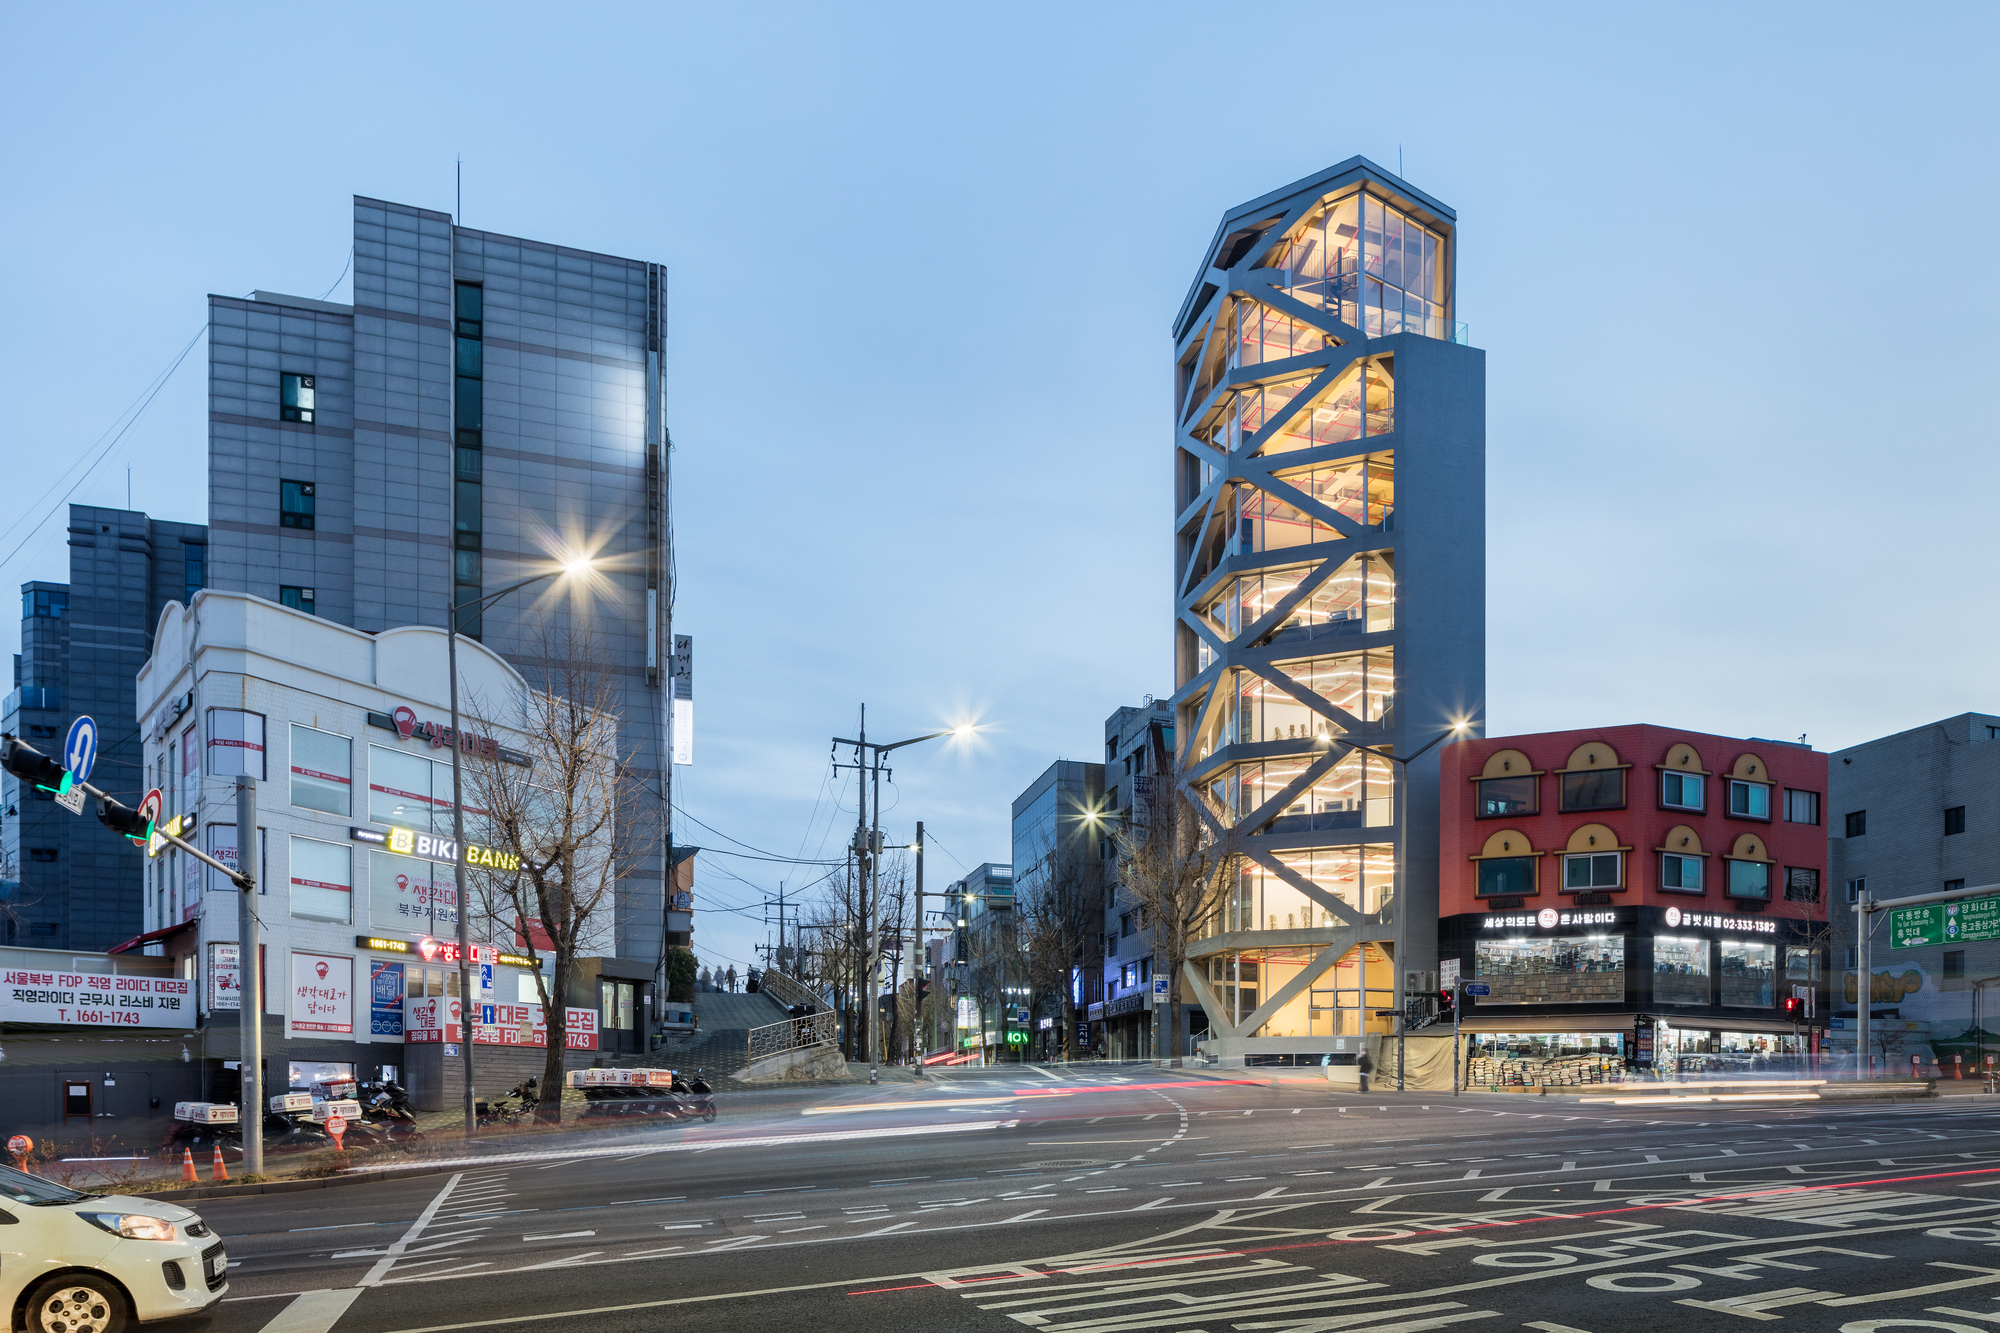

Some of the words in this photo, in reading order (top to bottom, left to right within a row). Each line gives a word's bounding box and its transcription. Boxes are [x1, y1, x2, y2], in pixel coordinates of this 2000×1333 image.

[422, 721, 499, 758] 생각대로
[467, 846, 520, 871] BANK
[1961, 901, 1997, 914] 양화대교
[1683, 914, 1722, 928] 글벗서점
[1897, 927, 1920, 939] 홍익대
[370, 938, 406, 951] 1661-1743
[3, 971, 54, 987] 서울북부
[58, 975, 83, 988] FDP
[87, 977, 111, 990] 직영
[116, 979, 150, 992] 라이더
[154, 981, 188, 994] 대모집
[376, 985, 397, 996] 배달
[12, 989, 74, 1004] 직영라이더
[79, 992, 115, 1007] 근무시
[119, 995, 154, 1009] 리스비
[158, 997, 181, 1010] 지원
[297, 985, 347, 1000] 생각대로가
[307, 1000, 337, 1015] 답이다
[471, 1001, 529, 1025] 생대로
[58, 1009, 71, 1022] T.
[77, 1009, 140, 1025] 1661-1743
[543, 1032, 590, 1048] 1-1743
[1078, 1023, 1088, 1045] 고시원
